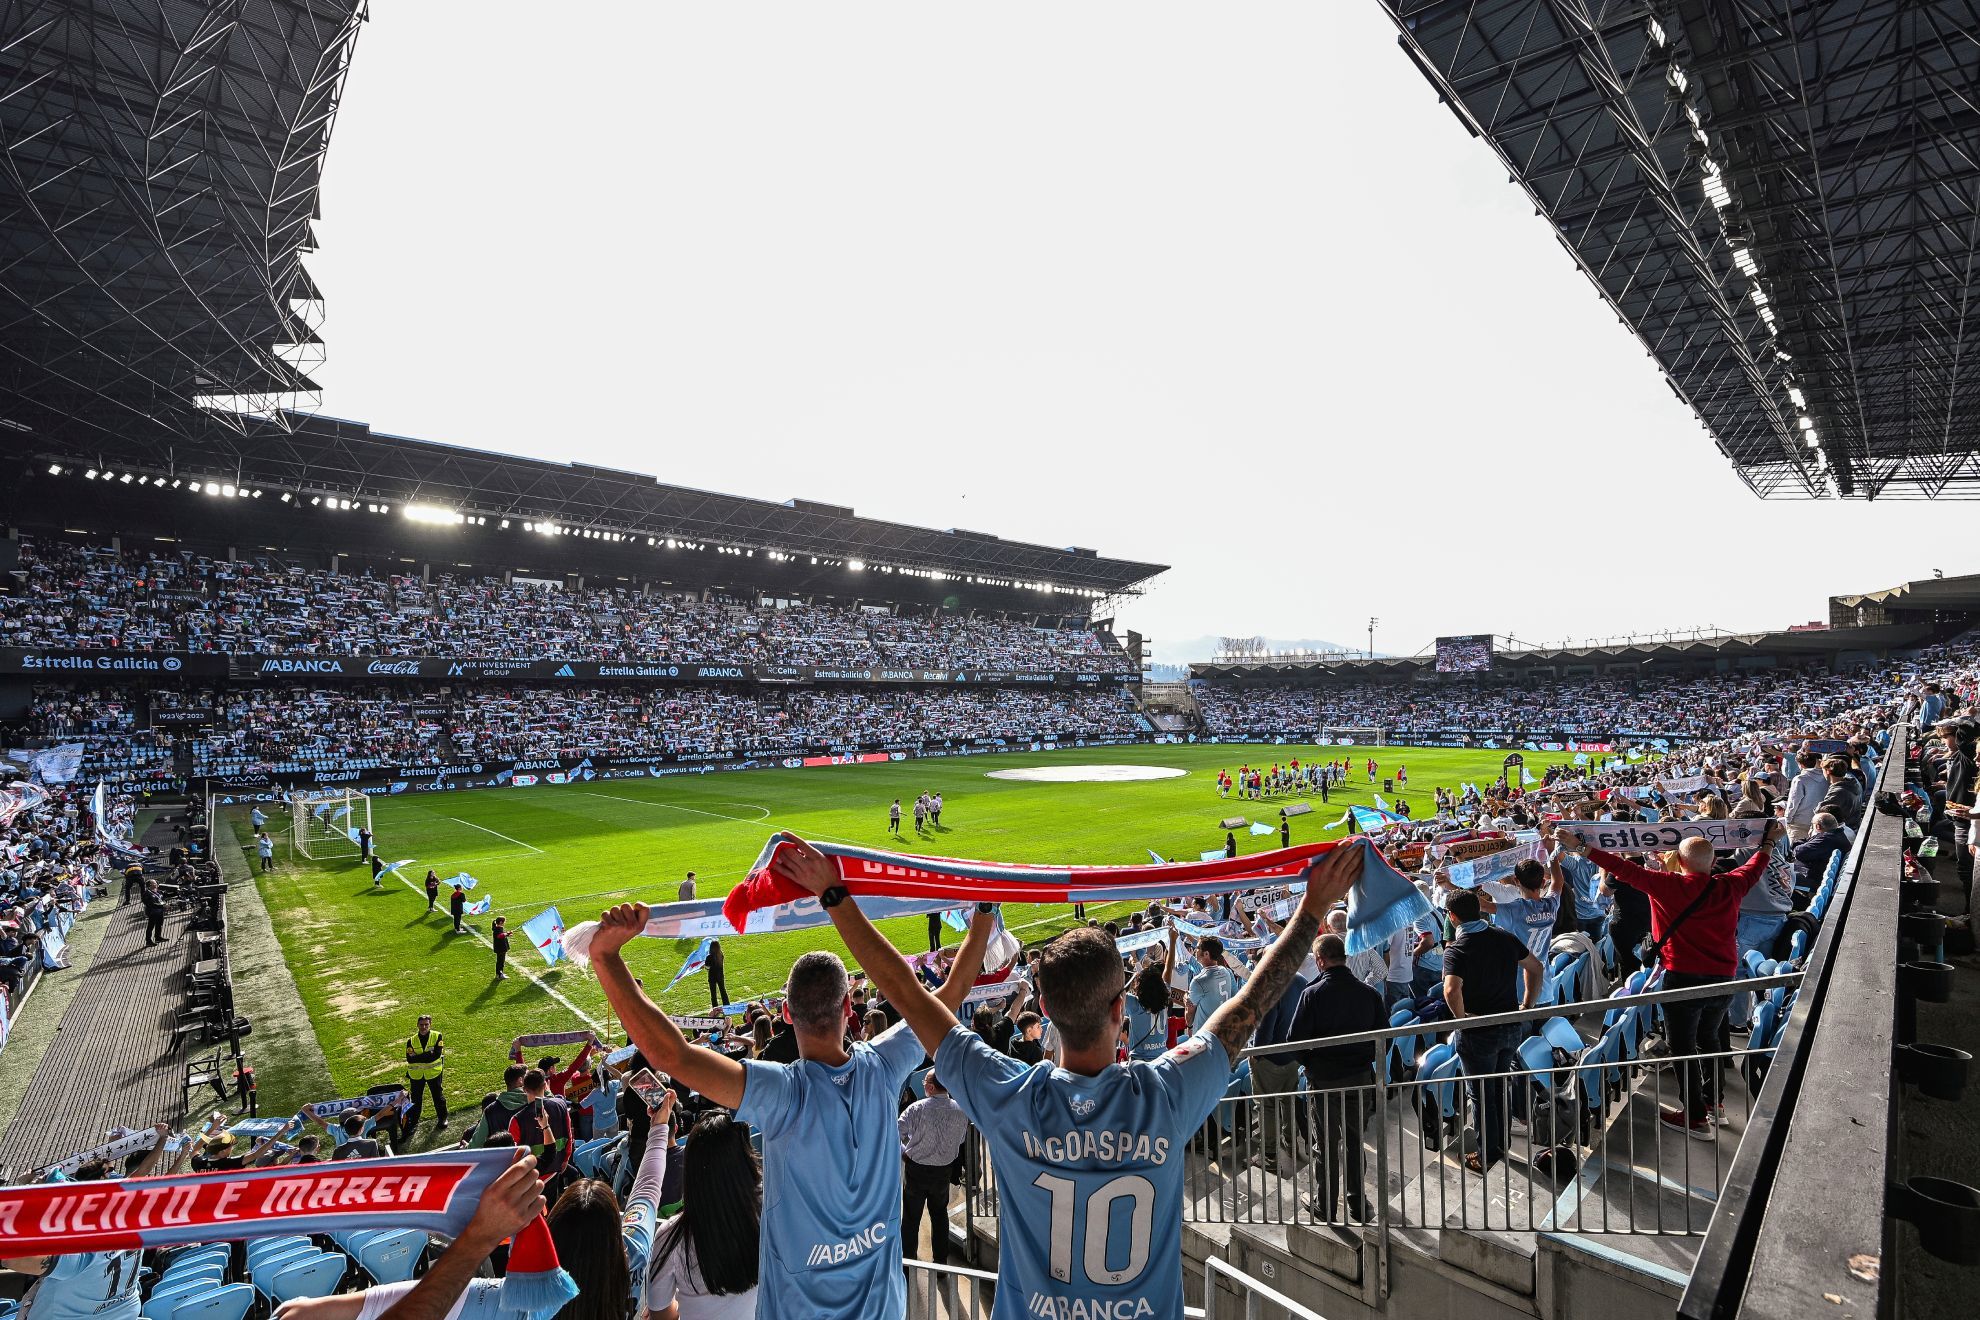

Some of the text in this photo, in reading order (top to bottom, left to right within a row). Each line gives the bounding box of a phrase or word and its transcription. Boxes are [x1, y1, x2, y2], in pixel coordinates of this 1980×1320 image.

[22, 655, 158, 669] Estrella Galicia
[266, 660, 343, 672] ABANCA
[598, 666, 667, 676] Estrella Galicia
[701, 668, 744, 678] ABANCA
[518, 760, 560, 770] ABANCA
[400, 765, 470, 776] Estrella Galicia
[314, 772, 360, 782] Recalvi
[416, 782, 456, 791] RCCeta
[40, 1184, 201, 1234] VENTO
[214, 1182, 250, 1220] E
[260, 1176, 431, 1214] MAREA
[1032, 1171, 1156, 1286] 10
